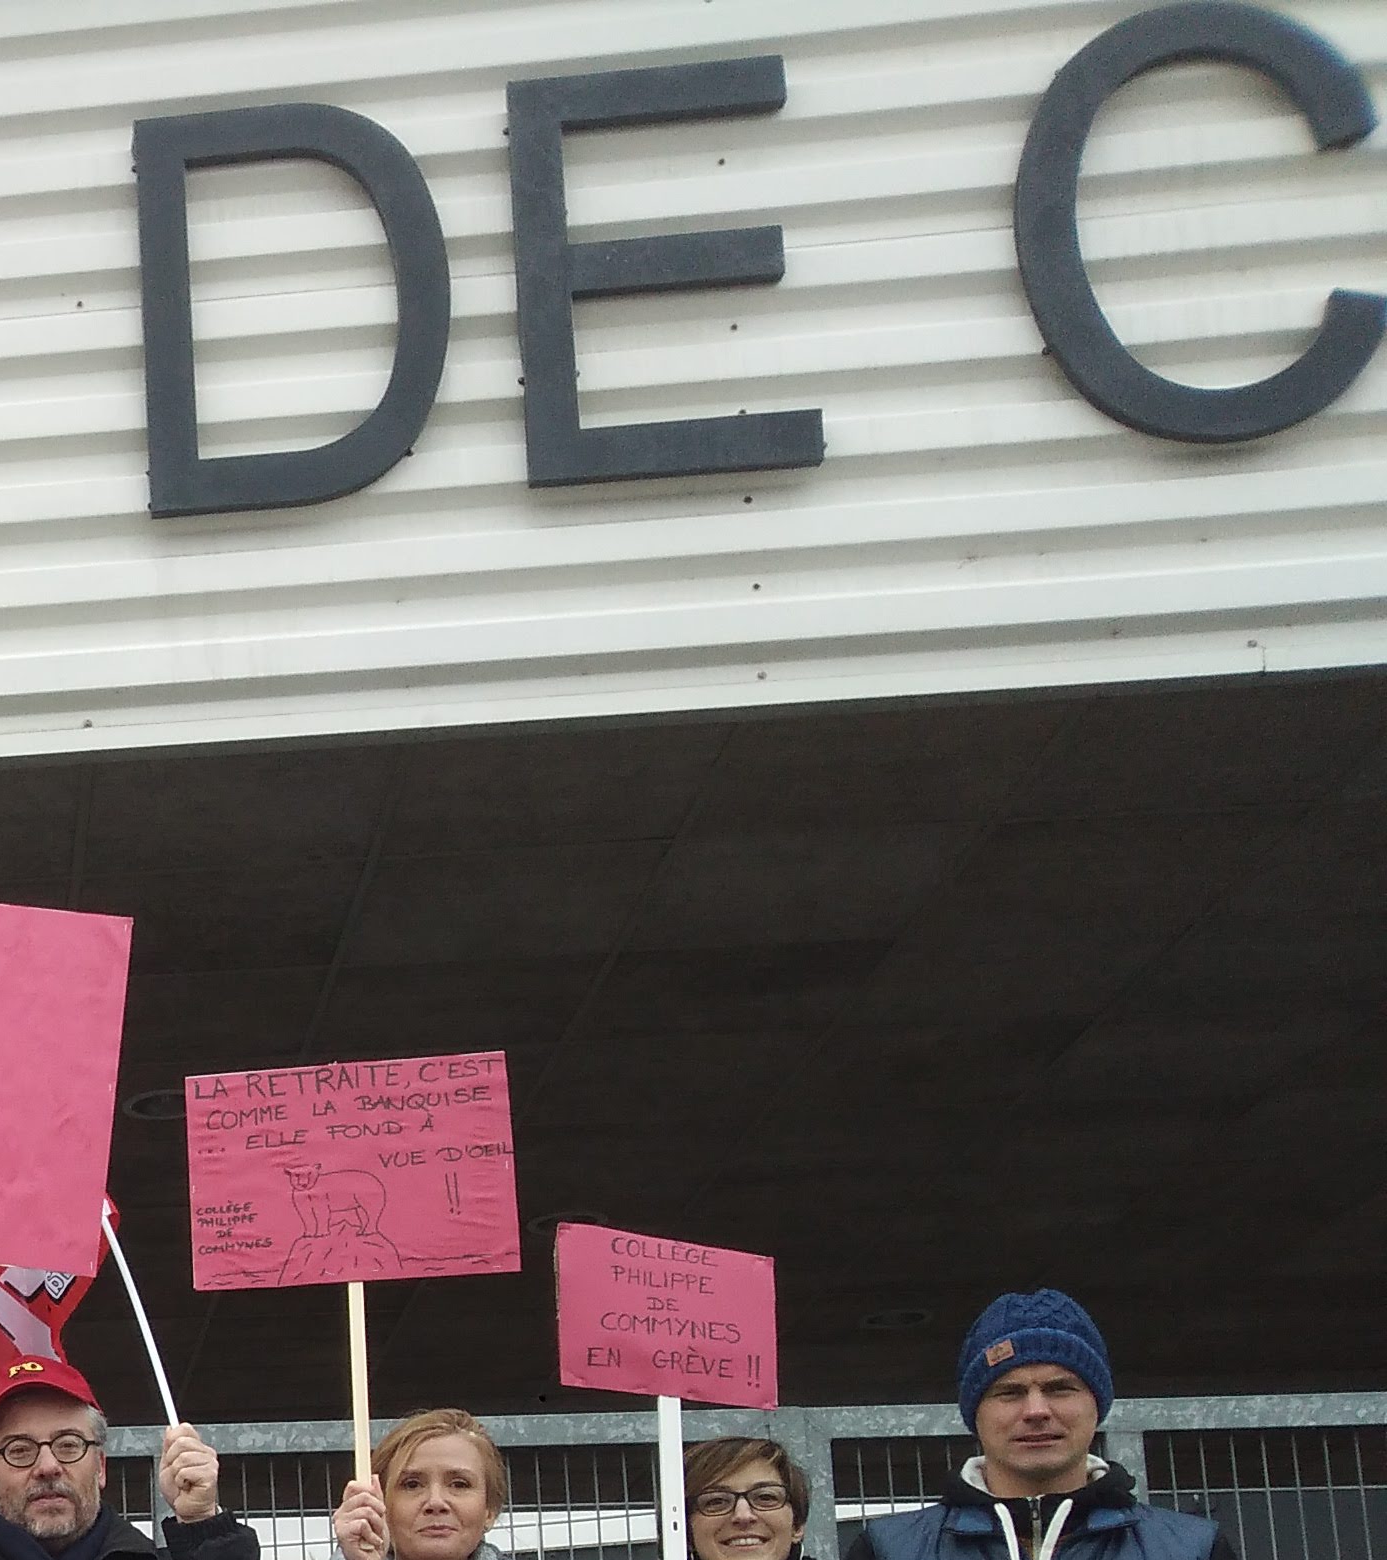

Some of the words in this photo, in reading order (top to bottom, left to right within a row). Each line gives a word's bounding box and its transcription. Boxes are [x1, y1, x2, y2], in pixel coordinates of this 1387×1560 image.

[133, 55, 823, 518] DE
[1014, 0, 1387, 444] C
[194, 1077, 229, 1100] LA
[245, 1063, 411, 1099] RETRAITE,
[418, 1058, 504, 1083] C'EST
[206, 1104, 289, 1131] COMME
[312, 1099, 337, 1117] LA
[354, 1085, 492, 1112] BANQUISE
[245, 1129, 309, 1150] ELLE
[325, 1120, 403, 1140] FOND
[378, 1150, 427, 1169] VUE
[435, 1141, 515, 1163] D'OEIL
[215, 1227, 235, 1239] DE
[610, 1264, 715, 1295] PHILIPPE
[646, 1296, 680, 1312] DE
[600, 1311, 742, 1345] COMMYNES
[586, 1346, 622, 1369] EN
[651, 1345, 735, 1379] GRÈVE
